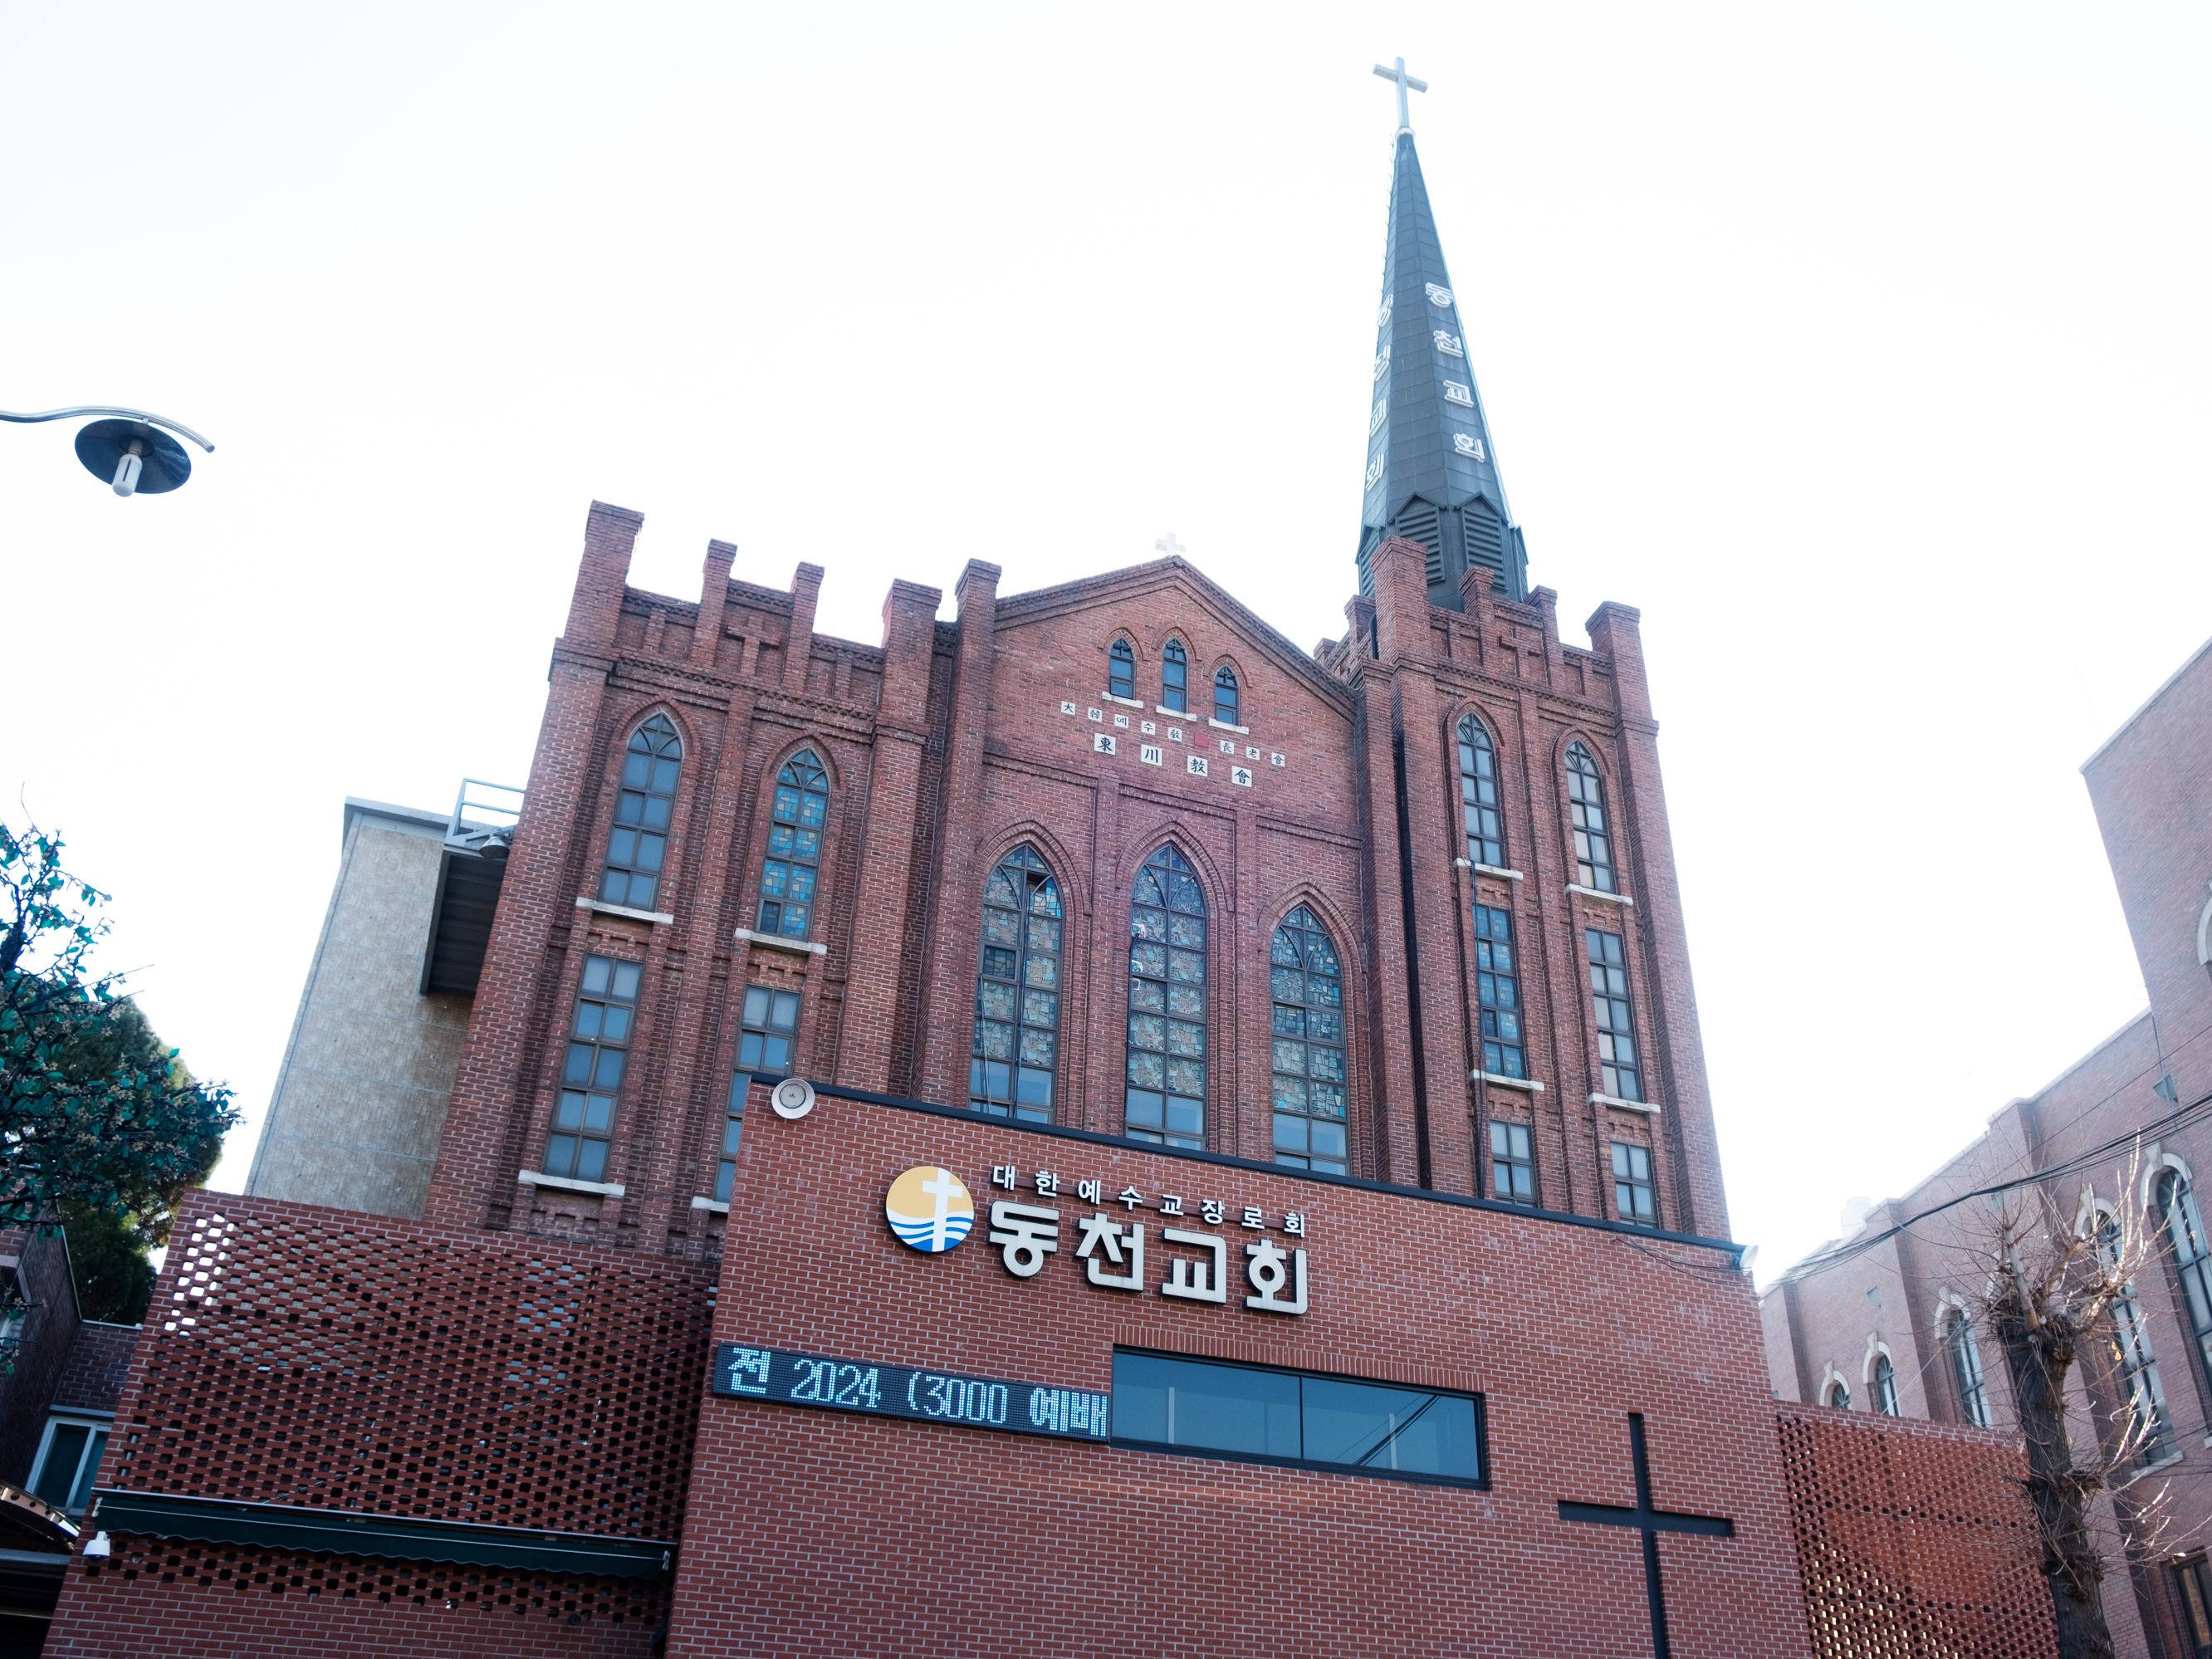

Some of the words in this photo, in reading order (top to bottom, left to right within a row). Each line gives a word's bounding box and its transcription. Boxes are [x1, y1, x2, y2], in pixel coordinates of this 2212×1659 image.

[1426, 282, 1485, 462] 동천교회
[992, 1164, 1305, 1238] 대한예수교장로회
[989, 1201, 1308, 1315] 동천교회
[727, 1347, 771, 1394] 전
[790, 1358, 882, 1408] 2024
[1030, 1387, 1108, 1437] 예배
